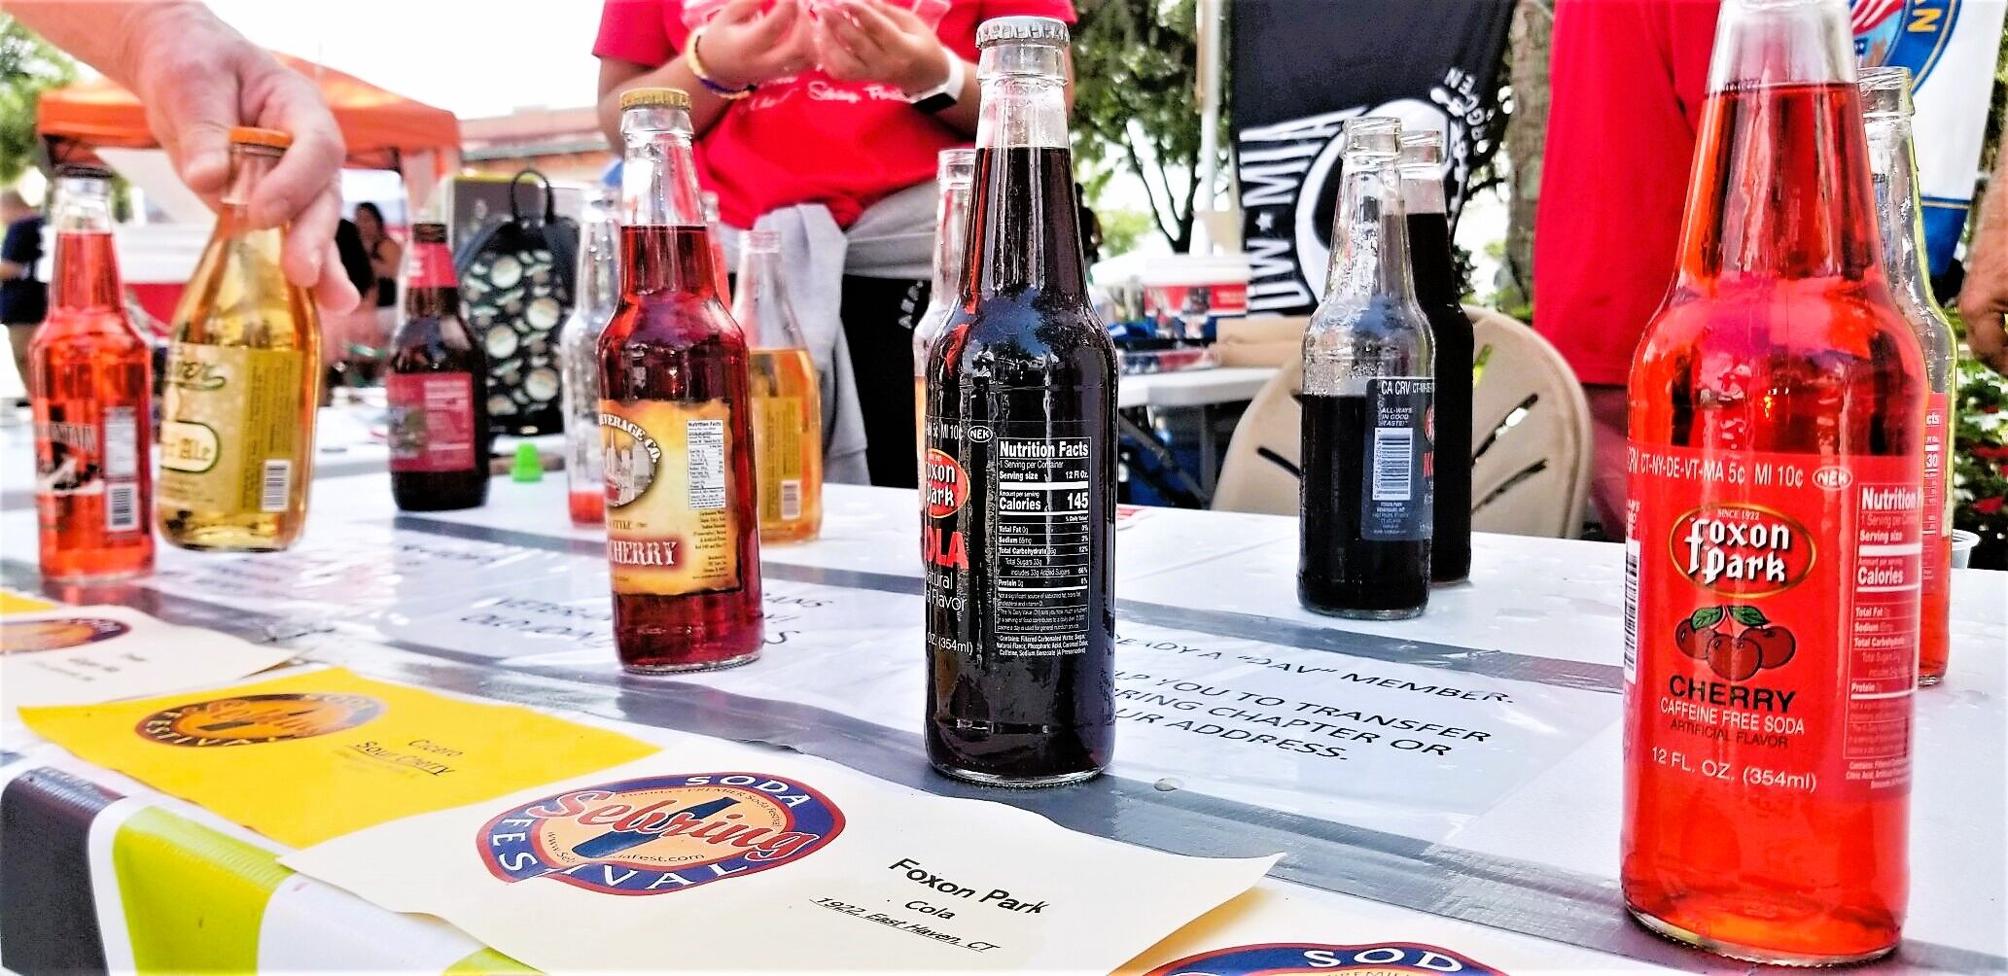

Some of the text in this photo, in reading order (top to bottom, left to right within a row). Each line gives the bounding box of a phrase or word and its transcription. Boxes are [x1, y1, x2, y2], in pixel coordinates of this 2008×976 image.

[1381, 381, 1393, 395] CA
[1395, 381, 1410, 395] CRV
[970, 429, 989, 439] NEK
[645, 438, 662, 463] CO.
[1000, 441, 1088, 458] Nutrition Facts
[1000, 471, 1023, 481] Serving
[1025, 471, 1038, 479] size
[1065, 471, 1073, 479] 12
[1004, 460, 1026, 470] Serving
[1027, 462, 1036, 470] per
[1755, 463, 1772, 485] MI
[1000, 492, 1088, 510] Calories 145
[1861, 487, 1918, 511] Nutrition
[1860, 530, 1890, 544] Serving
[999, 579, 1017, 587] Protein
[1857, 566, 1904, 585] Calories
[938, 637, 973, 656] (354ml)
[1341, 673, 1514, 703] MEMBER.
[1669, 675, 1796, 713] CHERRY
[1115, 688, 1452, 756] RING CHAPTER OR
[1156, 678, 1229, 697] YOU
[1237, 692, 1286, 706] TO
[1298, 702, 1492, 742] TRANSFER
[1660, 697, 1805, 735] CAFFEINE FREE SODA
[1116, 708, 1349, 760] UR ADDRESS.
[1671, 718, 1789, 748] ARTIFICIAL FLAVOR
[1652, 746, 1817, 793] 12 FL. OZ. (354ml)
[685, 775, 810, 808] SODA
[525, 790, 821, 861] Sebring
[888, 857, 1050, 914] Foxon Park
[904, 900, 956, 920] Cola
[865, 912, 905, 928] East
[967, 941, 1001, 953] CT
[1303, 948, 1463, 972] SOD
